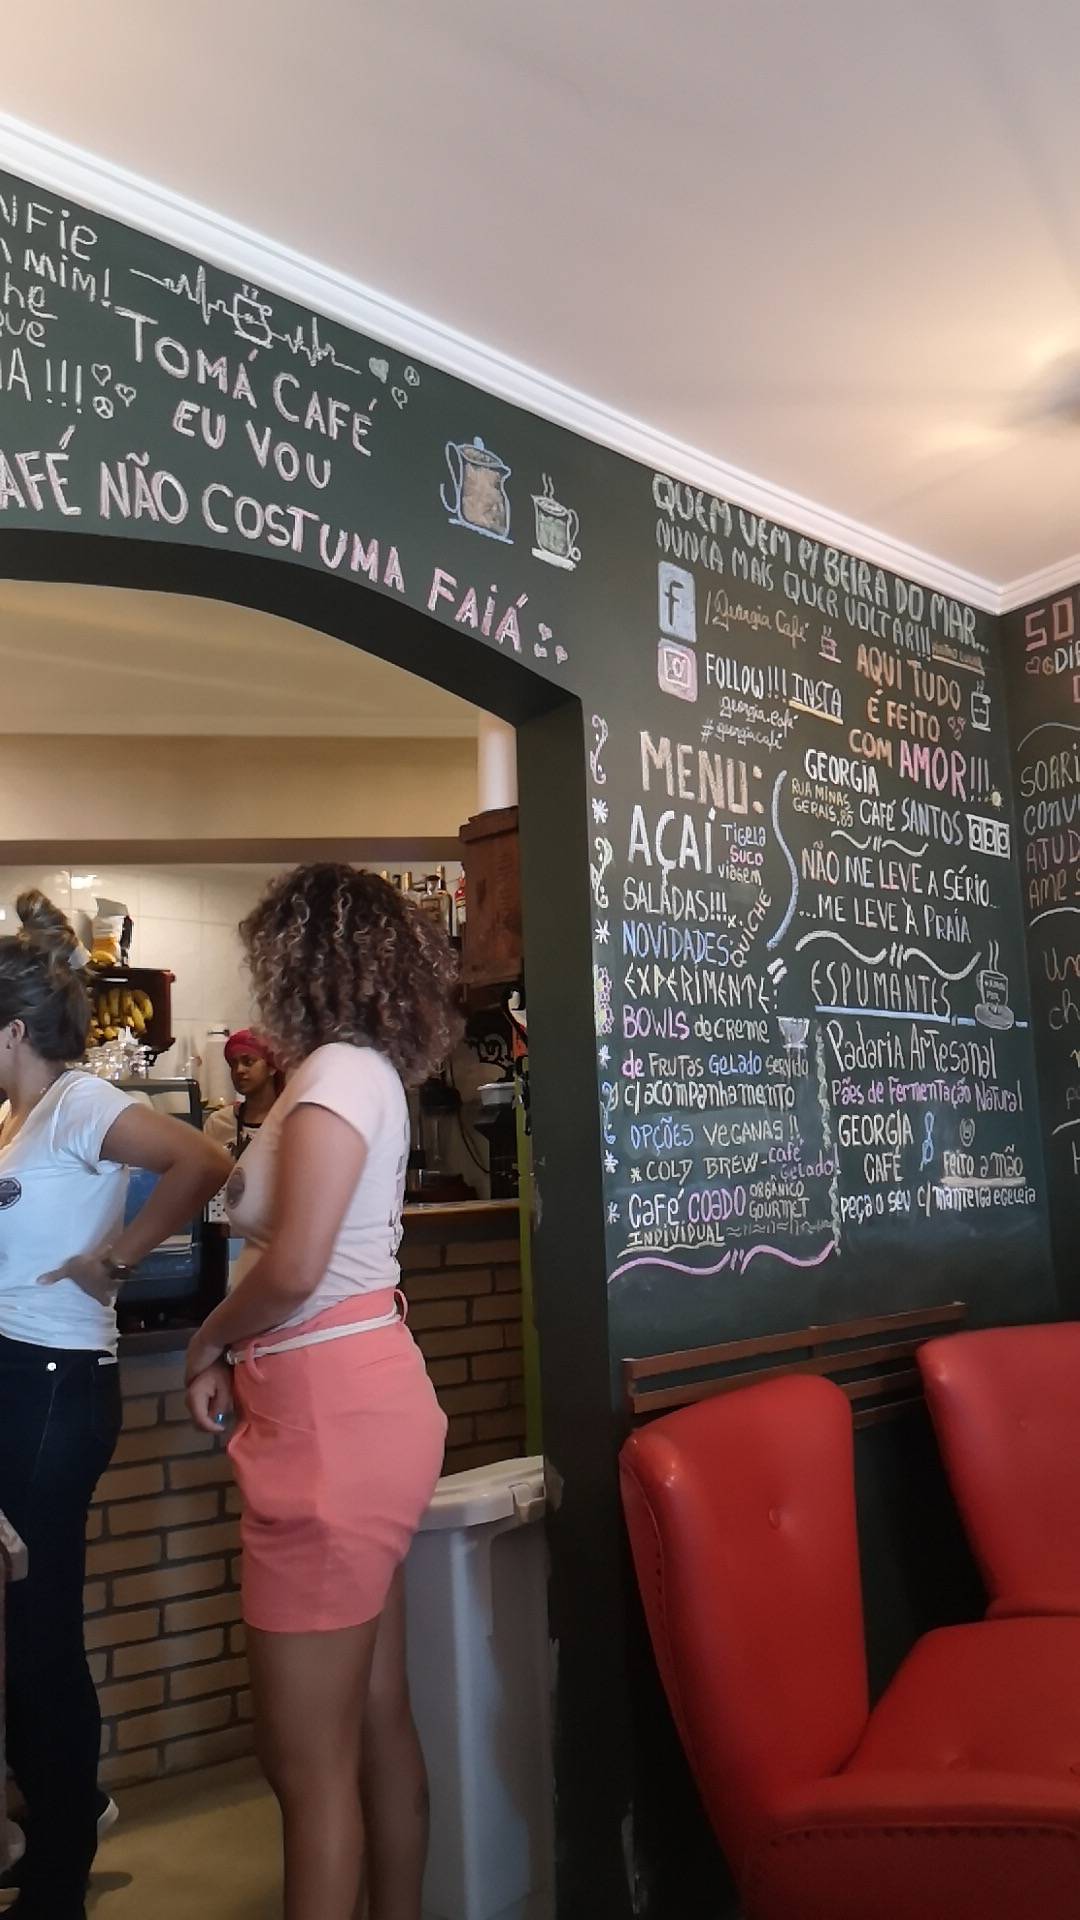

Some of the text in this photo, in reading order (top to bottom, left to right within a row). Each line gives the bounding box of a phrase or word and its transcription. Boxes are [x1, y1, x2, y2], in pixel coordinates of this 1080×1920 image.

[114, 305, 377, 456] TOMÁ CAFÉ
[173, 400, 331, 489] EU VOU
[100, 451, 189, 525] NÃO
[202, 483, 405, 593] COSTUMA
[652, 473, 733, 538] QUEM
[739, 508, 791, 565] VEM
[824, 547, 889, 609] BEIRA
[895, 577, 924, 622] DO
[656, 517, 724, 574] NUNCA
[783, 570, 838, 618] QUER
[705, 652, 842, 720] FOLLOW!!! INSTA
[867, 689, 882, 723] É
[907, 659, 961, 711] TUDO
[640, 731, 765, 814] MENU:
[804, 749, 880, 797] GEORGIA
[849, 728, 990, 802] COM AMOR!!!
[815, 784, 851, 811] MINAS
[901, 797, 964, 846] SANTOS
[801, 841, 840, 885] NÃO
[846, 855, 875, 888] ME
[878, 859, 923, 894] LEVE
[927, 871, 939, 897] A
[729, 889, 772, 968] QUICHE
[854, 897, 899, 932] LEVE
[811, 960, 950, 1018] ESPUMANTES
[622, 1004, 691, 1040] BOWLS
[622, 1049, 645, 1080] de
[868, 1079, 884, 1104] de
[631, 1116, 694, 1156] OPÇÕES
[838, 1109, 914, 1147] GEORGIA
[646, 1158, 693, 1185] COLD
[863, 1147, 904, 1184] CAFÉ
